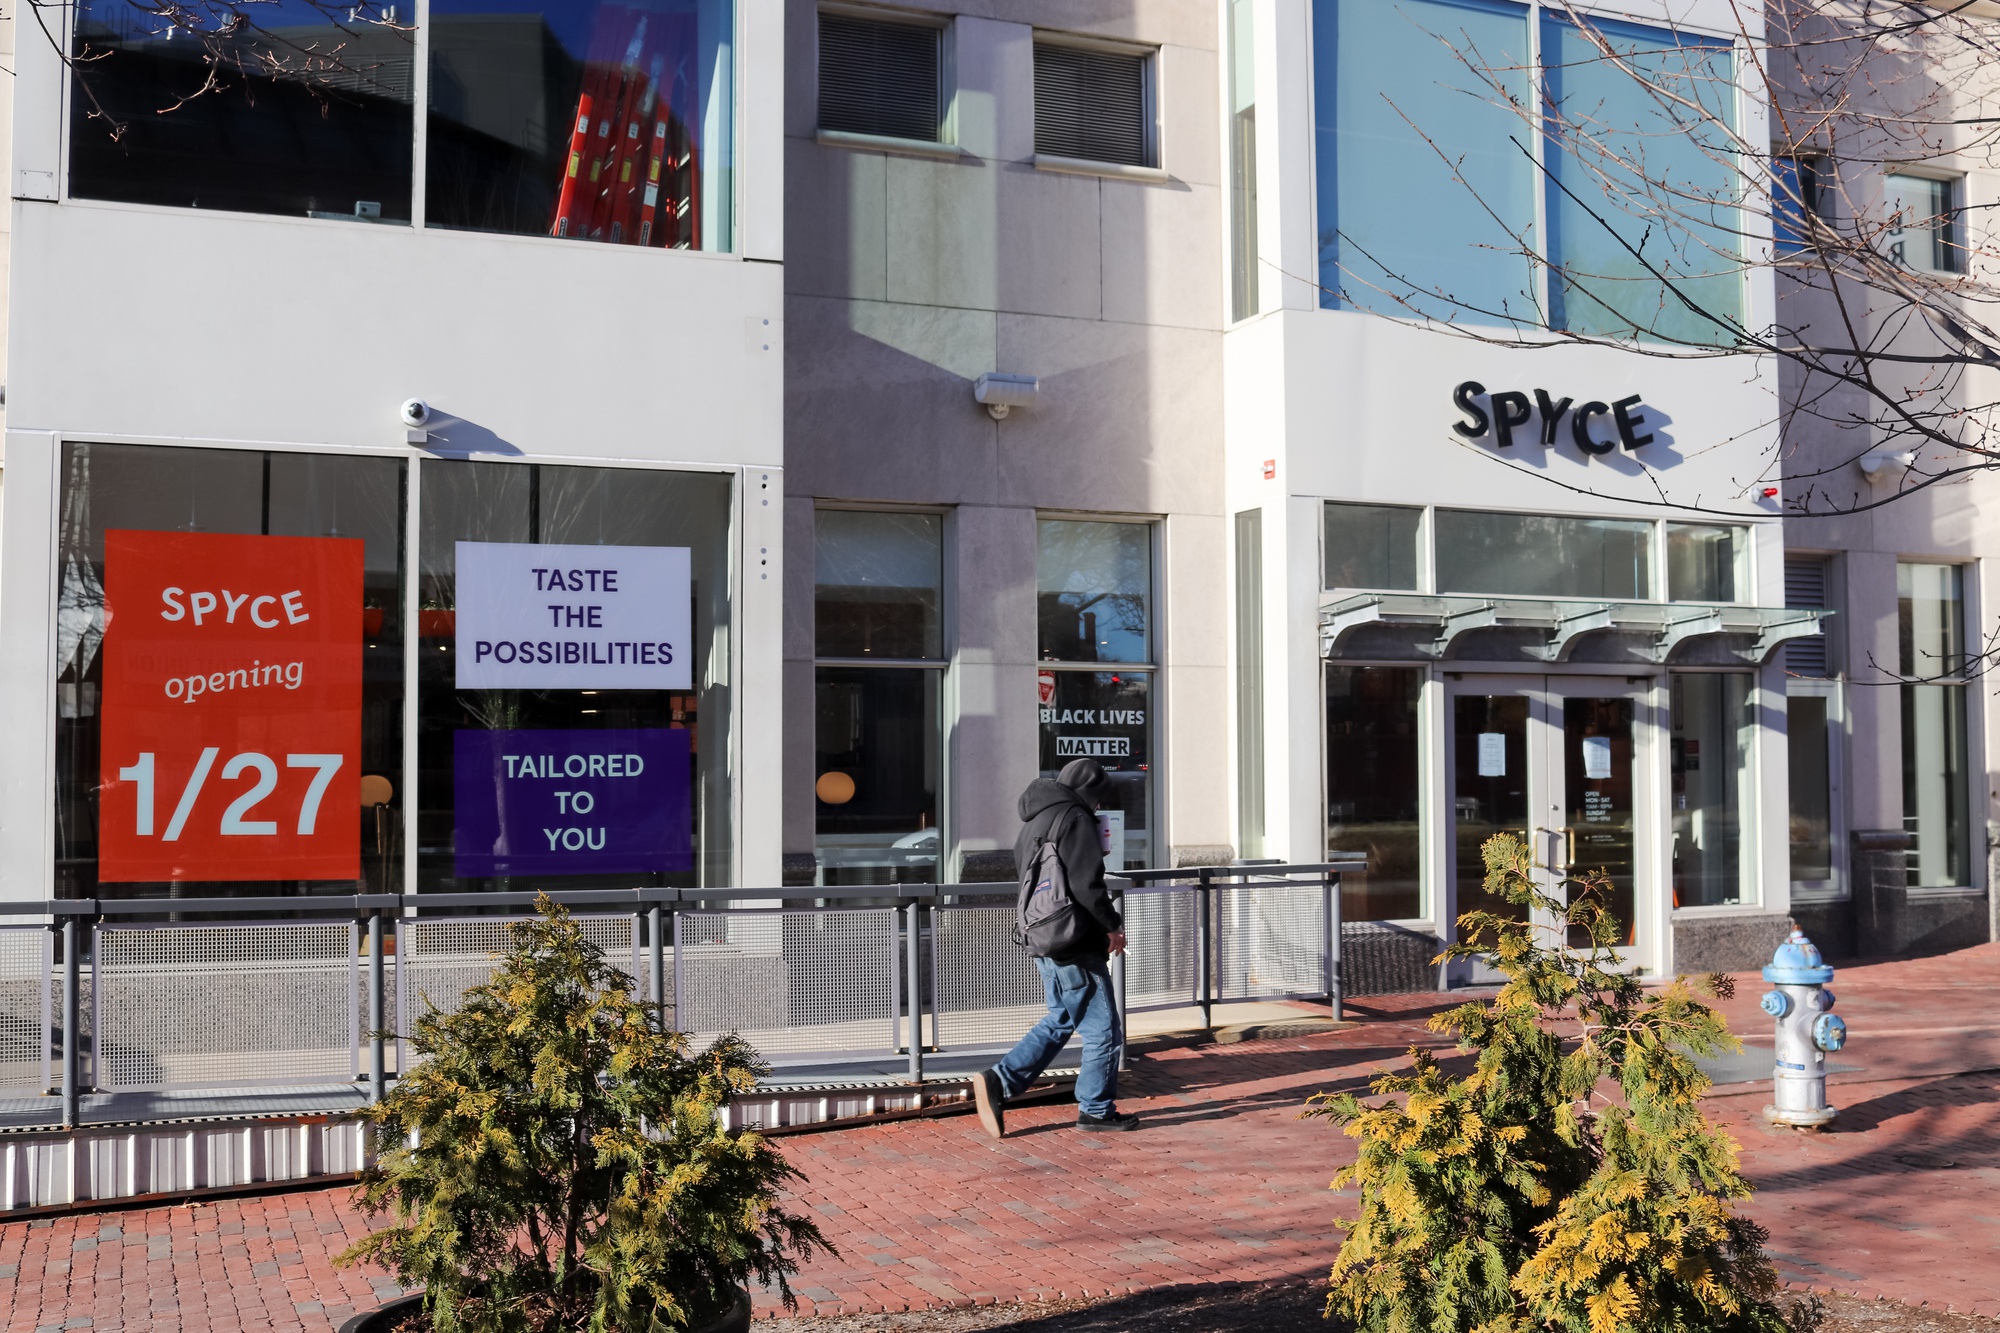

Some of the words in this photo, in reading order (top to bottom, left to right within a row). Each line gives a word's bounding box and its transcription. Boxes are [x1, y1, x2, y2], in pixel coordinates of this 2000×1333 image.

[1452, 380, 1655, 455] SPYCE
[531, 568, 618, 592] TASTE
[160, 586, 309, 629] SPYCE
[548, 605, 603, 628] THE
[475, 641, 673, 665] POSSIBILITIES
[164, 660, 304, 704] opening
[1040, 708, 1095, 724] BLACK
[1100, 709, 1145, 725] LIVES
[1058, 739, 1129, 755] MATTER
[502, 754, 644, 778] TAILORED
[119, 747, 344, 842] 1/27
[554, 791, 594, 814] TO
[543, 827, 606, 851] YOU
